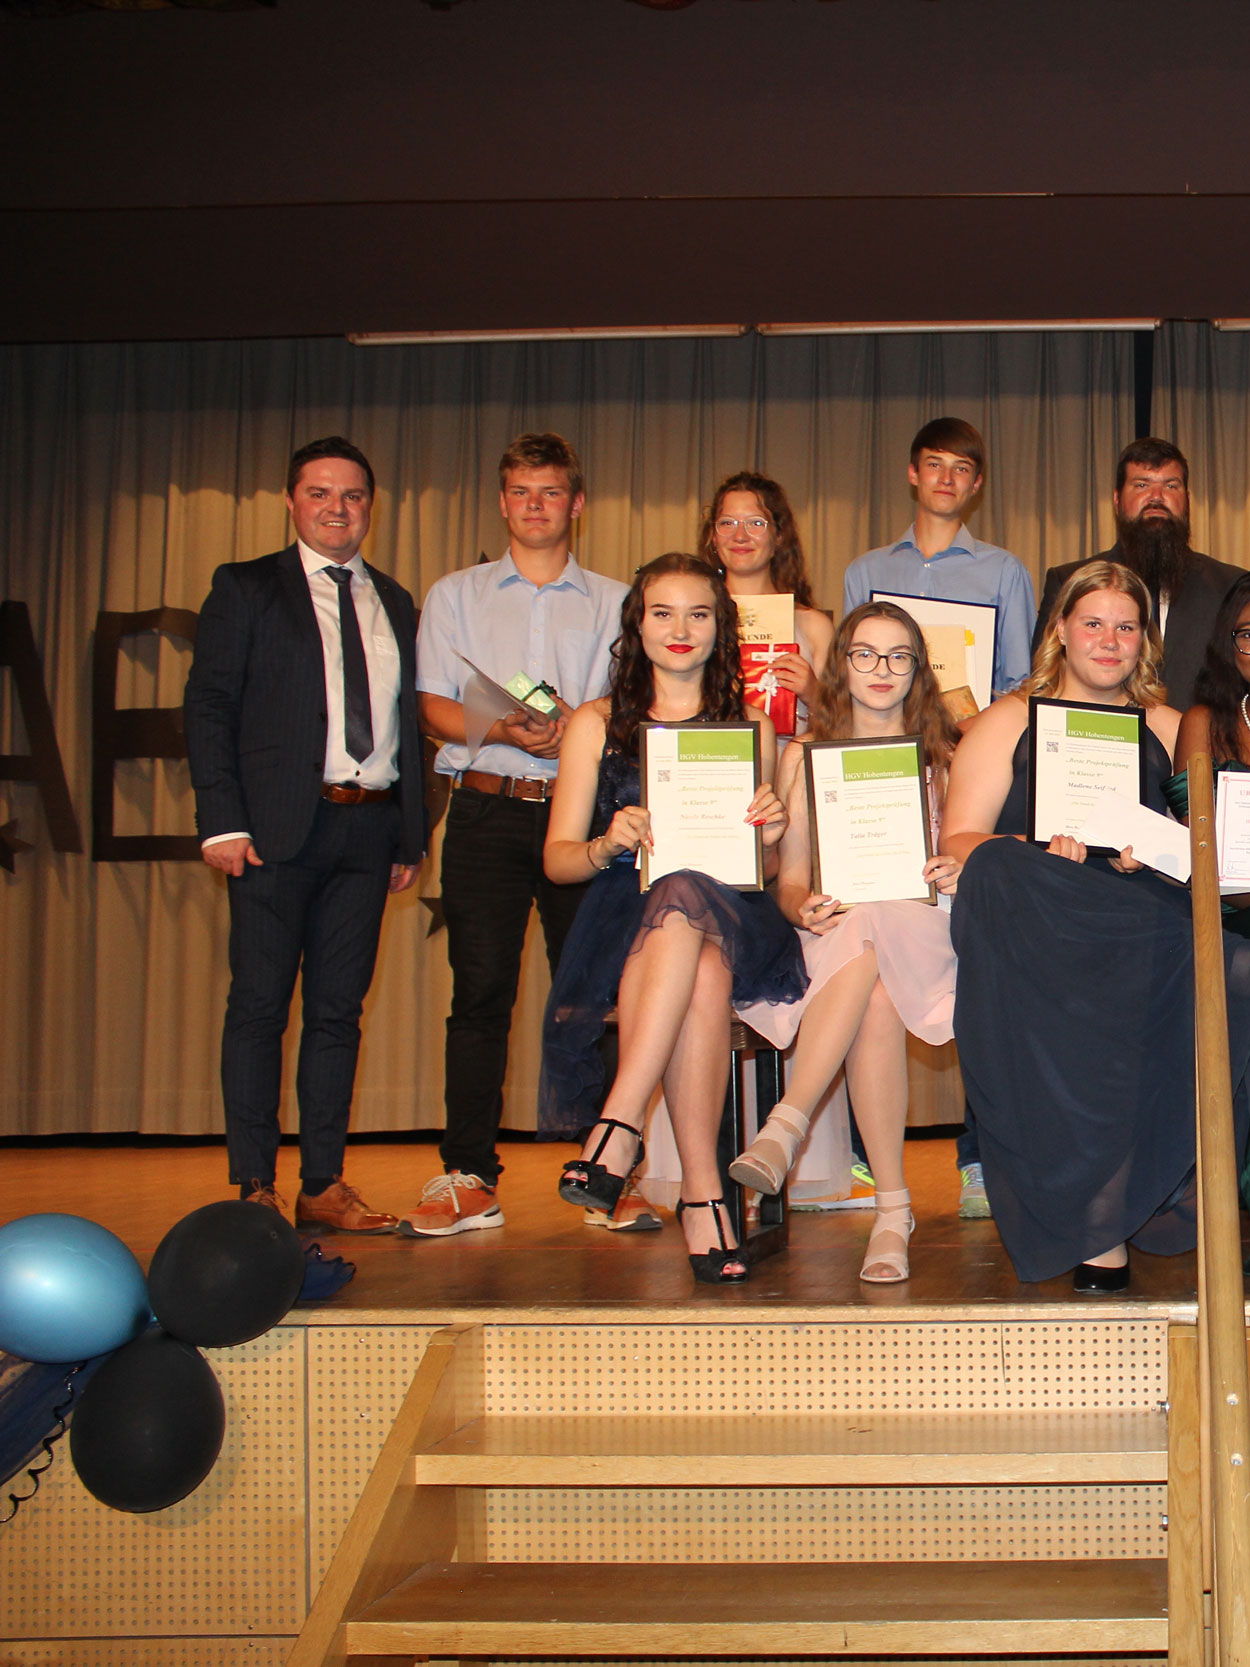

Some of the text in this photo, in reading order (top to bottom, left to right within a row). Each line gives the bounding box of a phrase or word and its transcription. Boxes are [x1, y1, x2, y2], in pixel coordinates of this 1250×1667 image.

[744, 633, 773, 641] UNDE
[1067, 729, 1084, 737] HGV
[1085, 730, 1125, 742] Hohentengen
[697, 753, 739, 761] Hohentengen
[845, 772, 861, 780] HGV
[863, 770, 904, 779] Hohentengen
